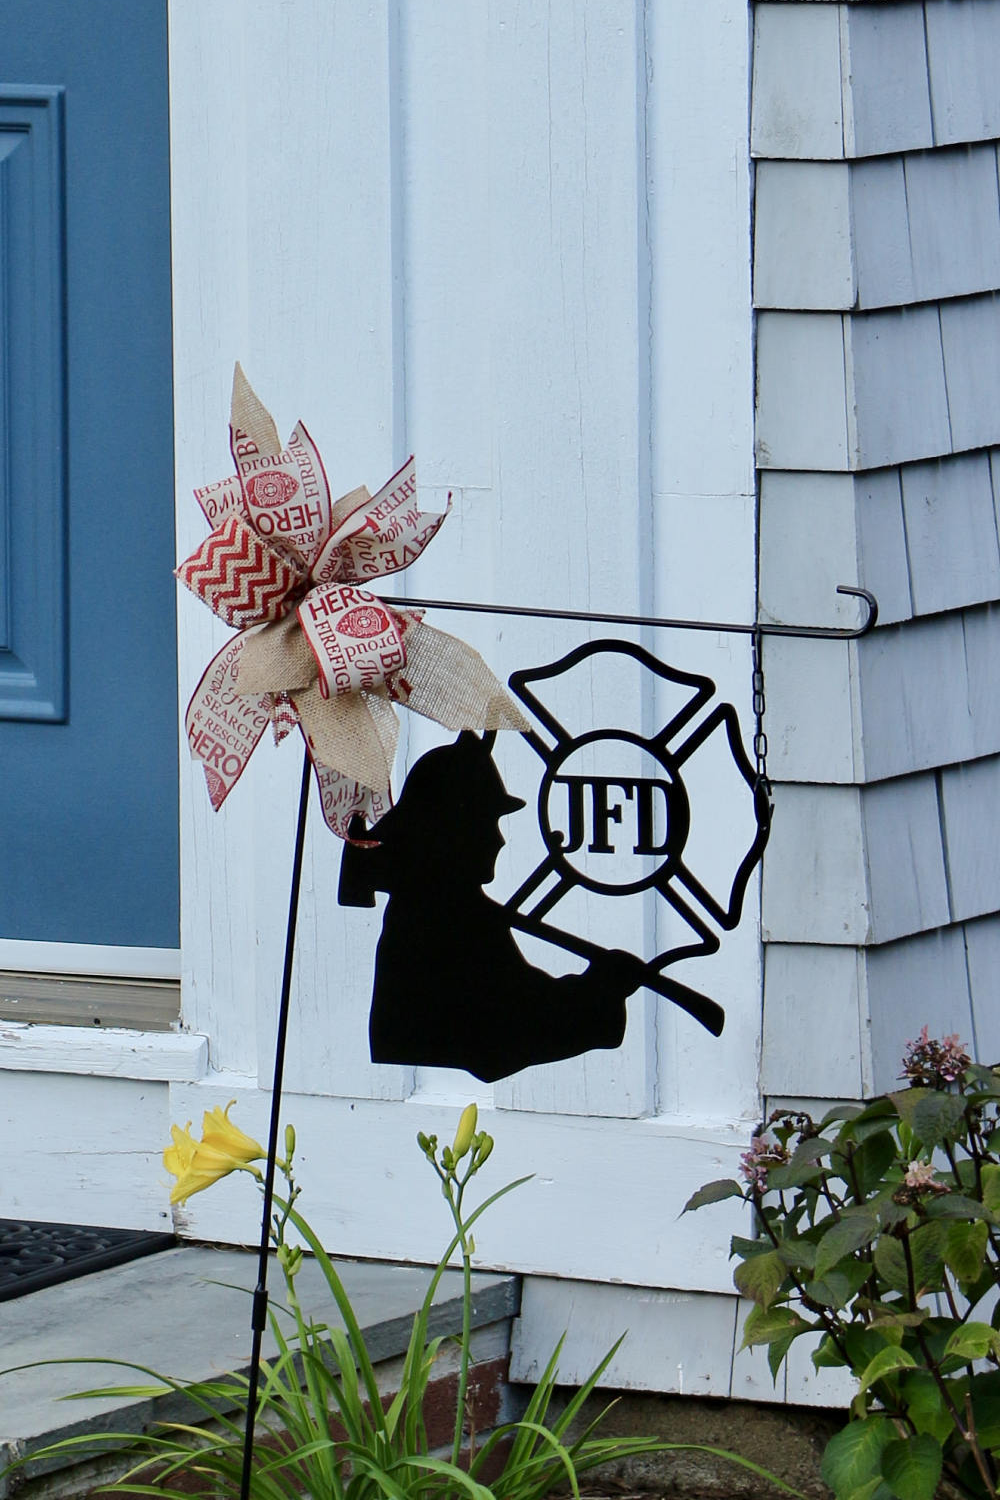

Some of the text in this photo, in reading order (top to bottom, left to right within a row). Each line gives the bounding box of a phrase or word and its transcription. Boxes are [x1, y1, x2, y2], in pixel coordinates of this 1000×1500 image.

[240, 452, 294, 477] proud
[255, 501, 323, 536] HERO
[376, 516, 403, 543] you
[209, 641, 244, 695] PROTECTOR
[344, 631, 399, 662] proud
[202, 694, 258, 745] SEARCH
[221, 687, 266, 729] Fire
[189, 722, 241, 777] HERO
[194, 709, 250, 759] & RESCUE
[551, 775, 673, 855] JFD
